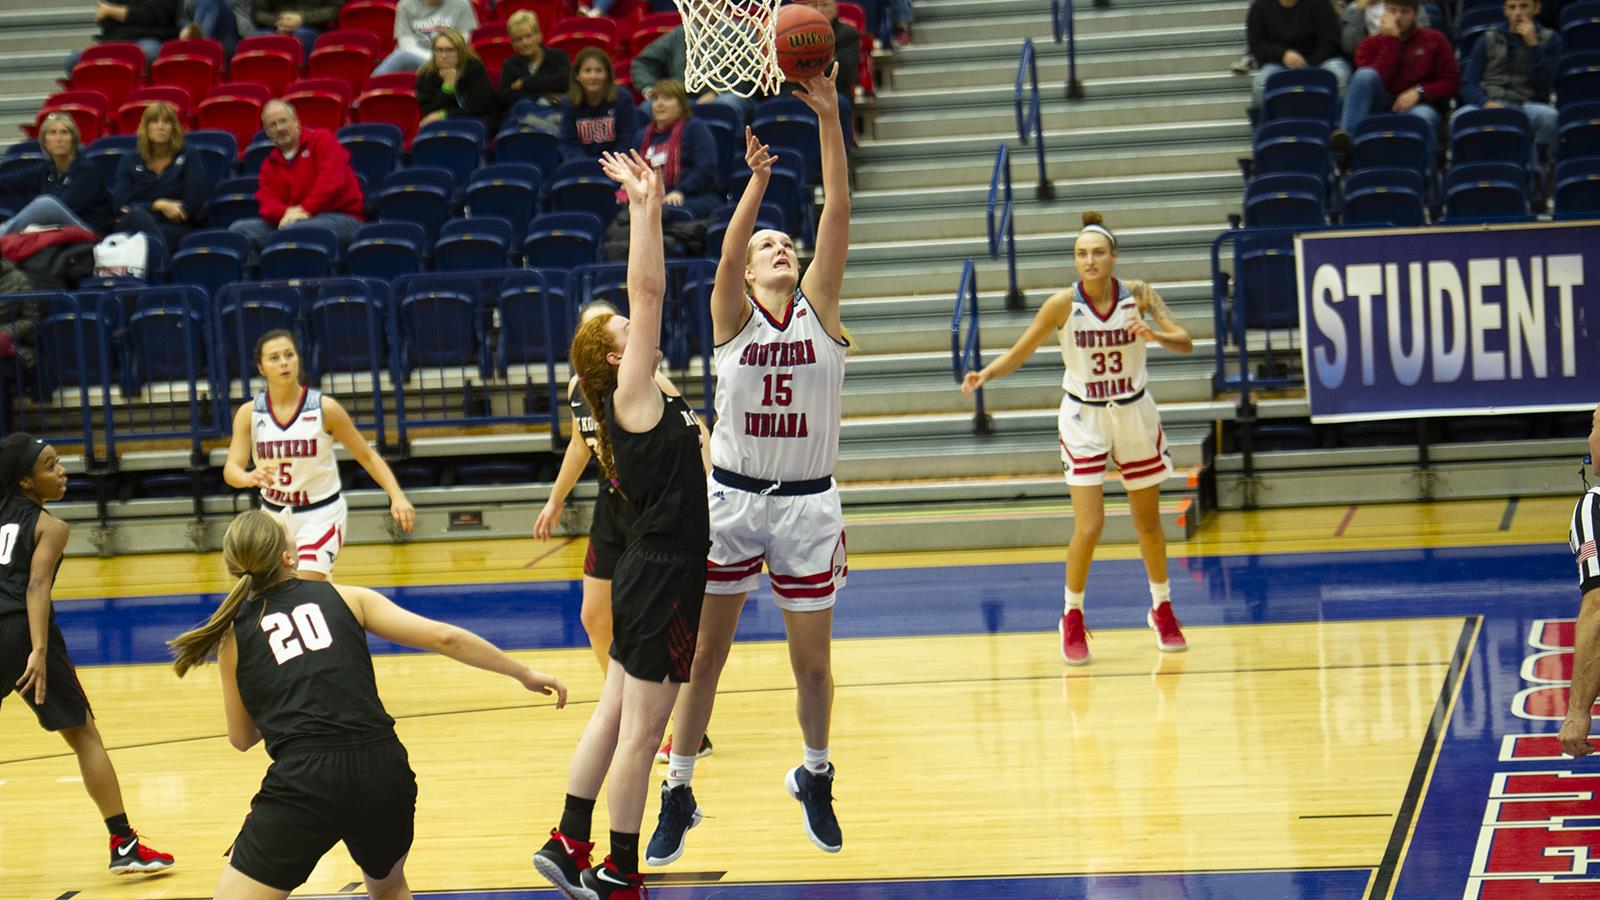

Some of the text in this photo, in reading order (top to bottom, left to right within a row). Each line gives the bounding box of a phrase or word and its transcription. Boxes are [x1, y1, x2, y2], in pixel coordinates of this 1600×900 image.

[576, 116, 617, 144] USI
[1311, 253, 1584, 389] STUDENT
[739, 339, 817, 367] SOUTHERN
[1091, 351, 1123, 376] 33
[761, 373, 793, 407] 15
[1085, 377, 1136, 399] INDIANA
[744, 411, 808, 438] INDIANA
[279, 462, 293, 487] 5
[260, 602, 334, 666] 20
